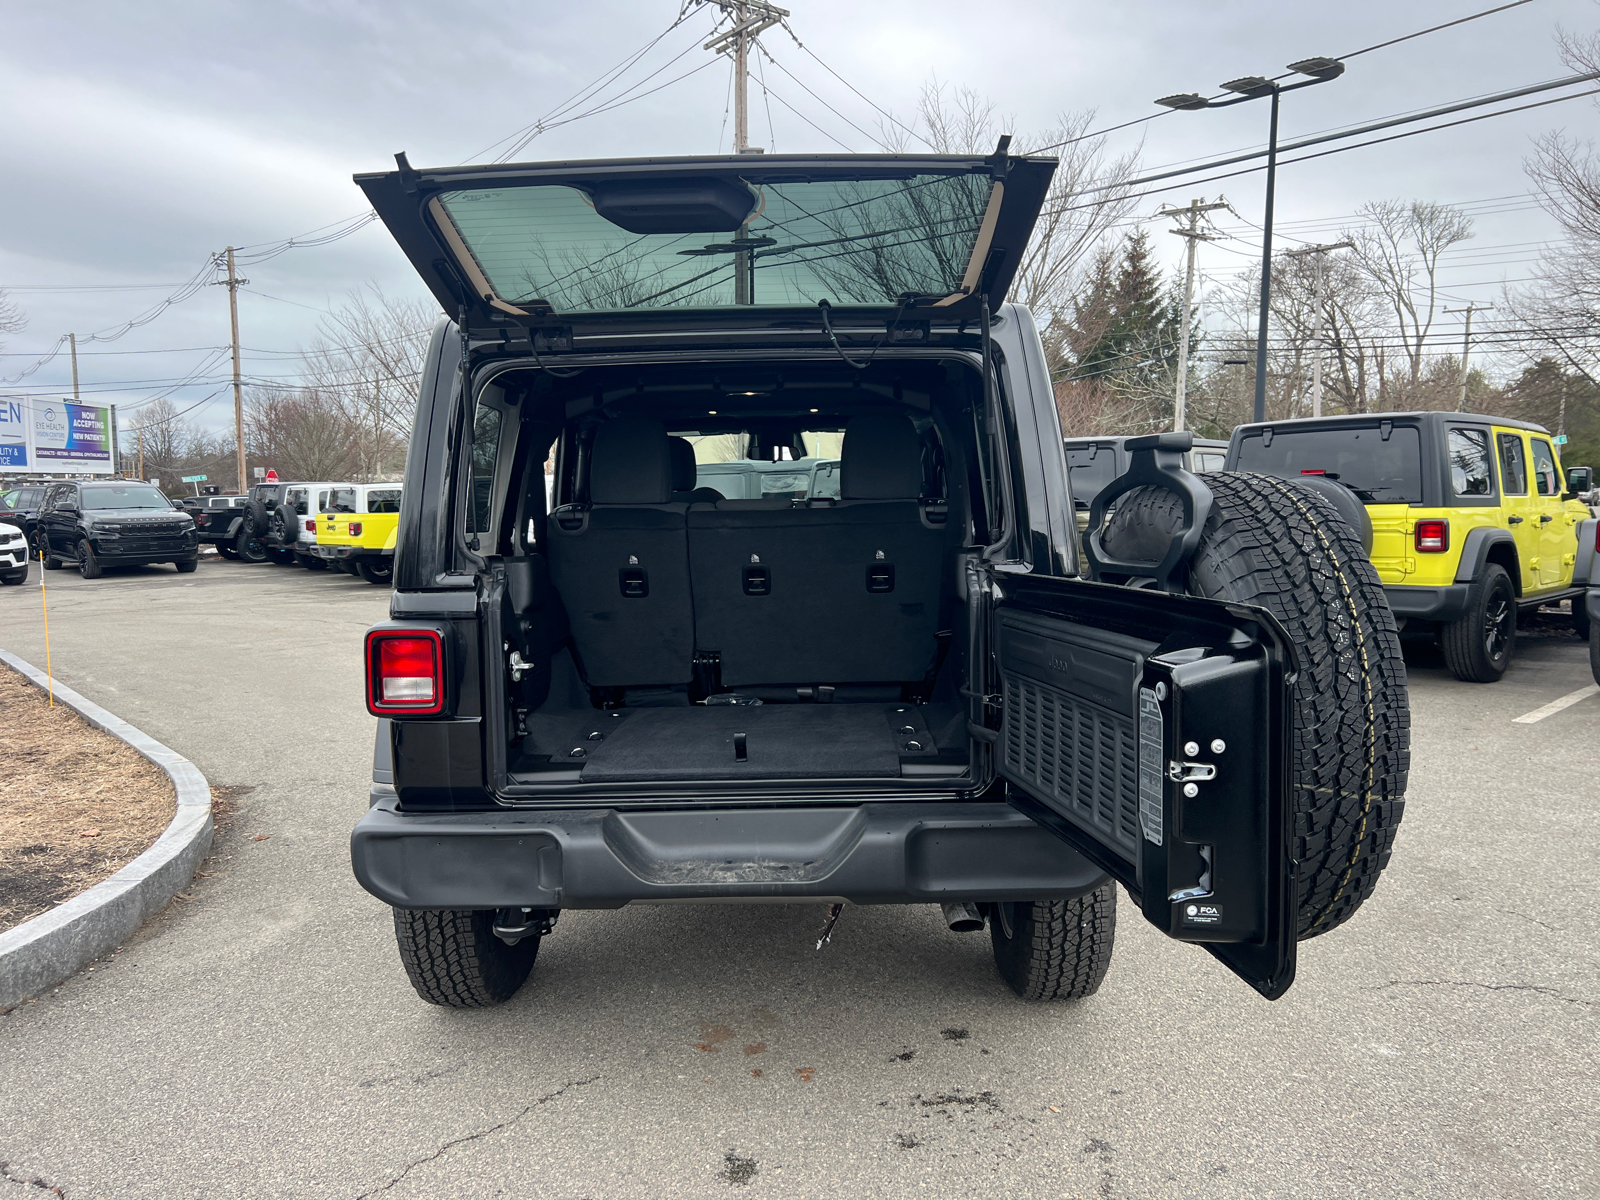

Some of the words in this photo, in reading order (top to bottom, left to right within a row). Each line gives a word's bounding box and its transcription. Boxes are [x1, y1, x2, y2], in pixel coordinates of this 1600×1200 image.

[82, 411, 96, 420] NOW
[36, 422, 45, 430] EYE
[46, 423, 65, 431] HEALTH
[73, 419, 105, 429] ACCEPTING
[72, 432, 84, 440] NEW
[13, 447, 19, 456] &
[1200, 906, 1218, 914] FCA
